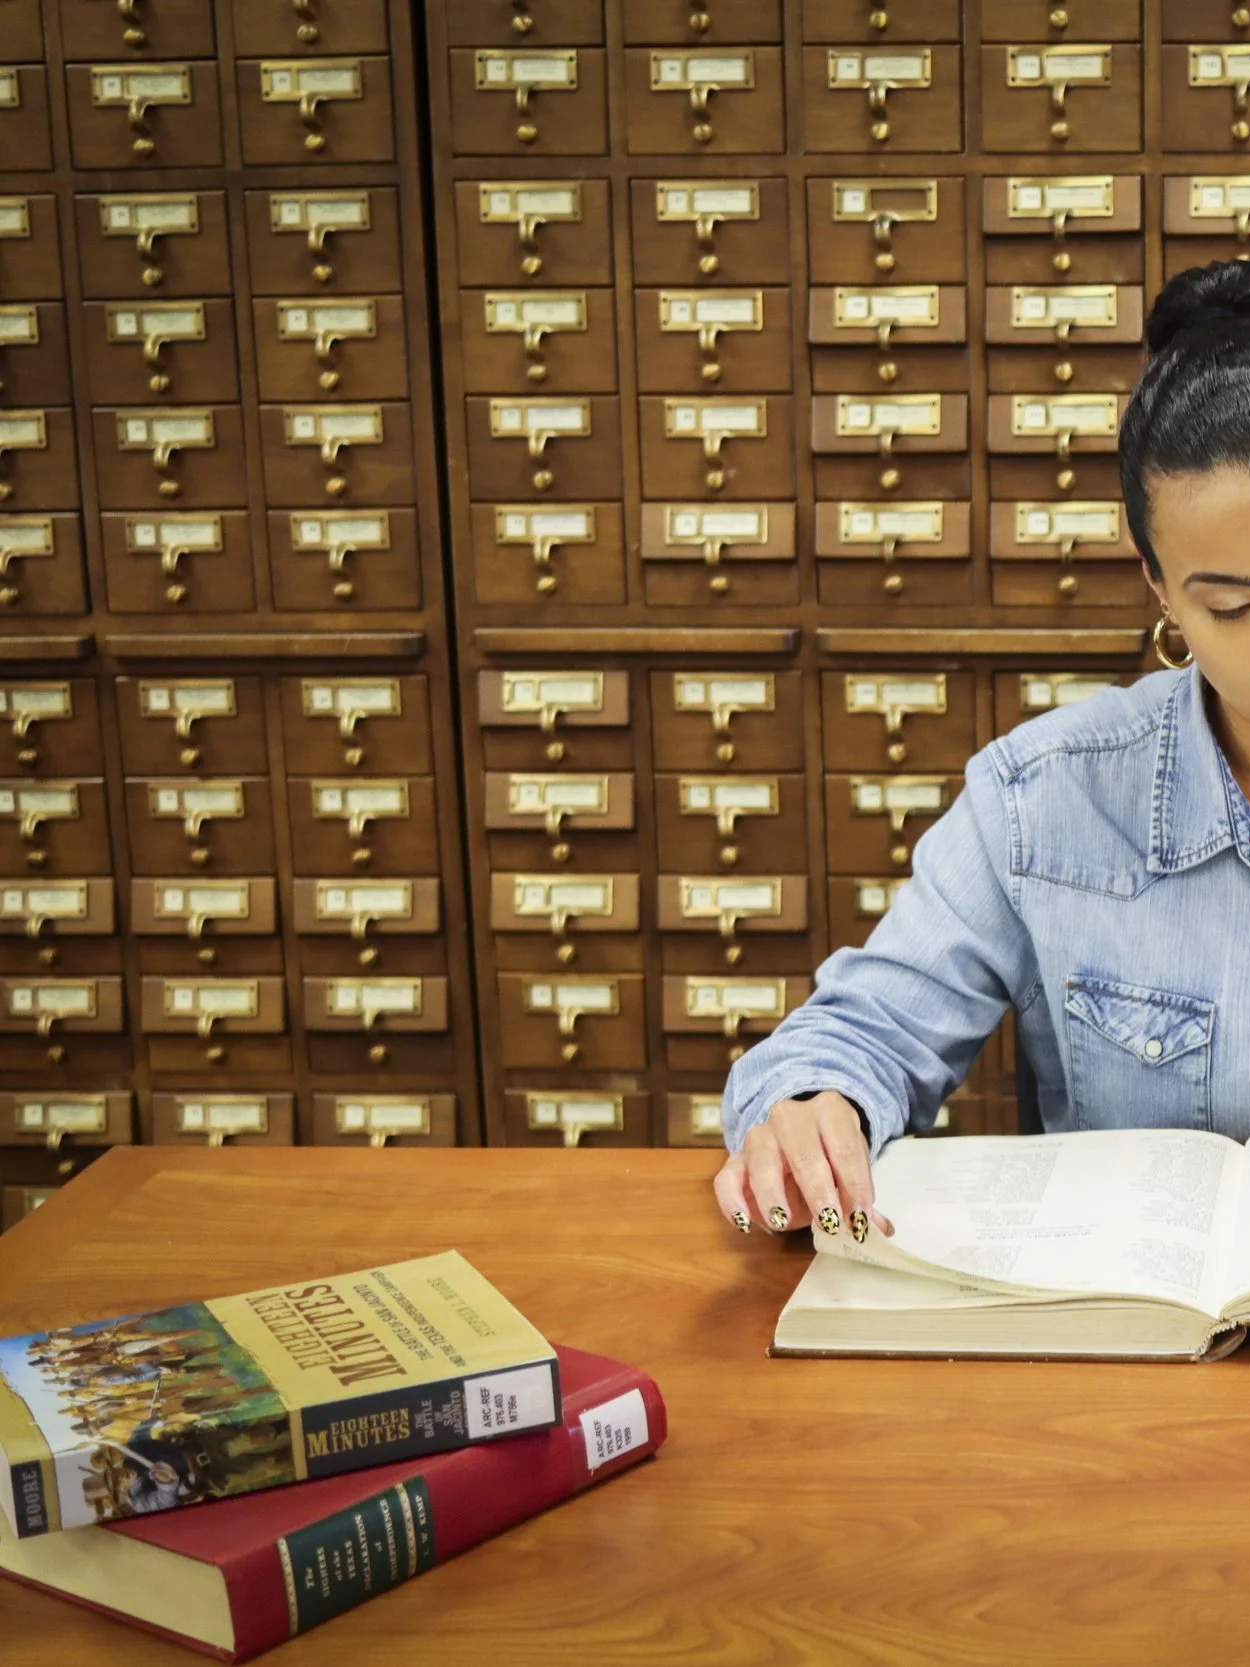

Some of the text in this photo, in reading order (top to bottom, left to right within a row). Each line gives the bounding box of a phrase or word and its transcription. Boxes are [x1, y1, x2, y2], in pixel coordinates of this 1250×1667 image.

[352, 1284, 386, 1308] JACINTO
[374, 1307, 398, 1322] SAN
[245, 1293, 338, 1370] EIGHTEEN
[285, 1285, 407, 1386] MINUTES
[390, 1327, 423, 1351] BATTLE
[419, 1325, 446, 1346] TEXAS
[330, 1408, 409, 1436] EIGHTEEN
[421, 1399, 435, 1438] BATTLE
[442, 1403, 454, 1426] SAN
[450, 1390, 464, 1435] JACINTO
[480, 1387, 492, 1427] ARC-REF
[306, 1422, 411, 1458] MINUTES
[593, 1419, 605, 1458] ARC-REF
[22, 1470, 43, 1529] MOORE
[415, 1495, 427, 1526] KEMP
[354, 1514, 372, 1591] DECLARATION
[380, 1498, 397, 1581] INDEPENDENCE
[304, 1566, 315, 1589] The
[316, 1546, 330, 1598] SIGNERS
[344, 1540, 356, 1580] TEXAS
